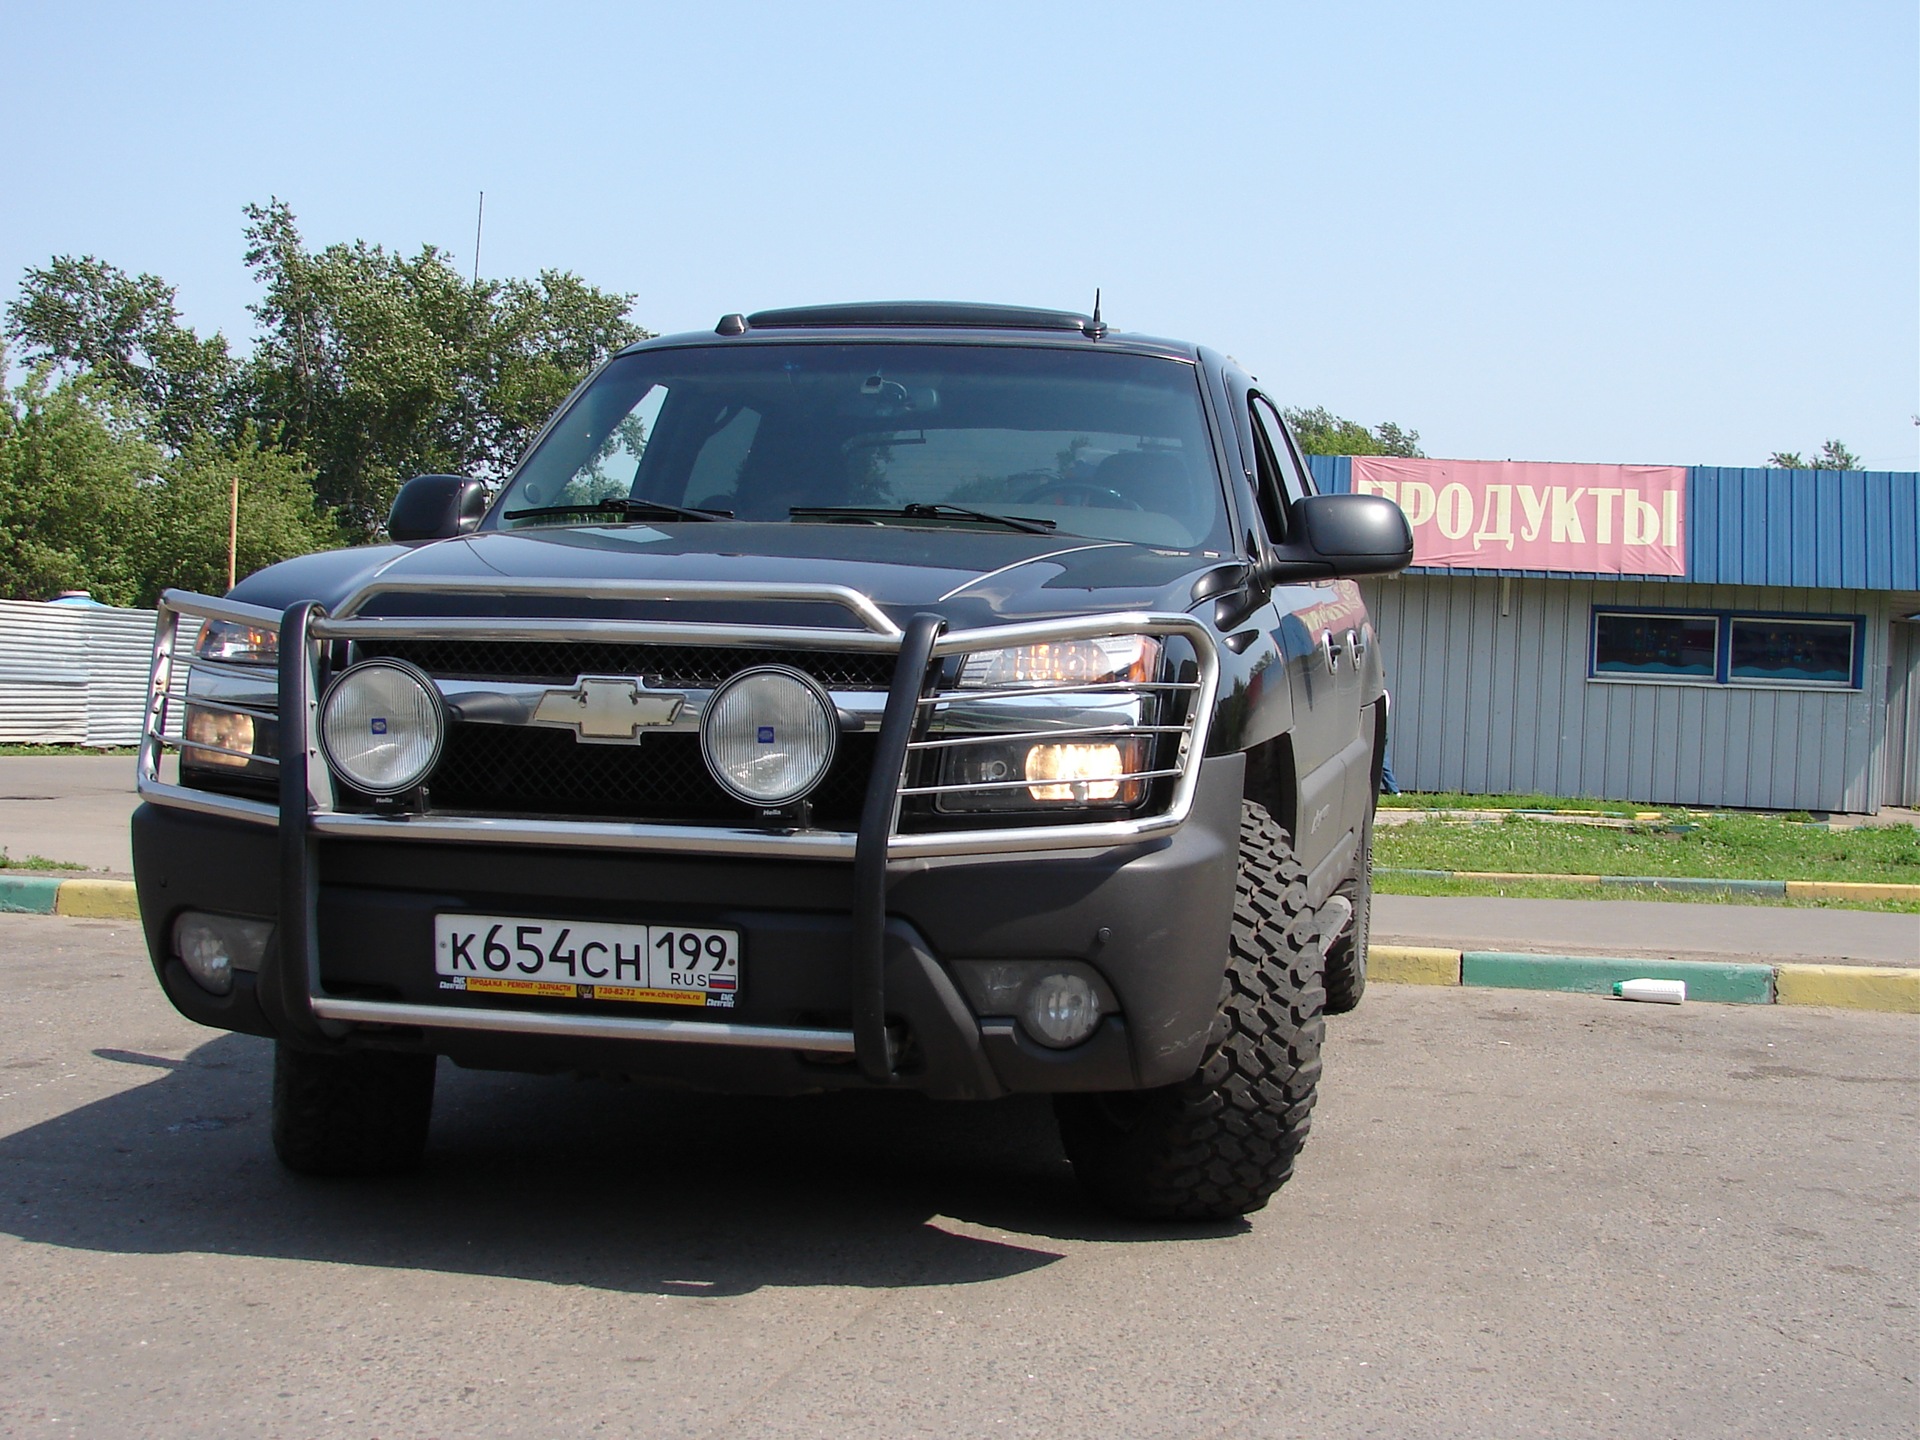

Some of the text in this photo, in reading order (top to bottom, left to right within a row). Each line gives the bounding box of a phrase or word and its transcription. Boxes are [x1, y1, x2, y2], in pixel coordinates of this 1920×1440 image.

[655, 931, 728, 972] 199
[470, 978, 571, 992] ПРОДАЖА РЕМОНТ ЗАПЧАСТИ
[670, 972, 707, 987] RUS
[599, 987, 636, 996] 730-82-72
[639, 991, 701, 1001] www.cheviplus.ru
